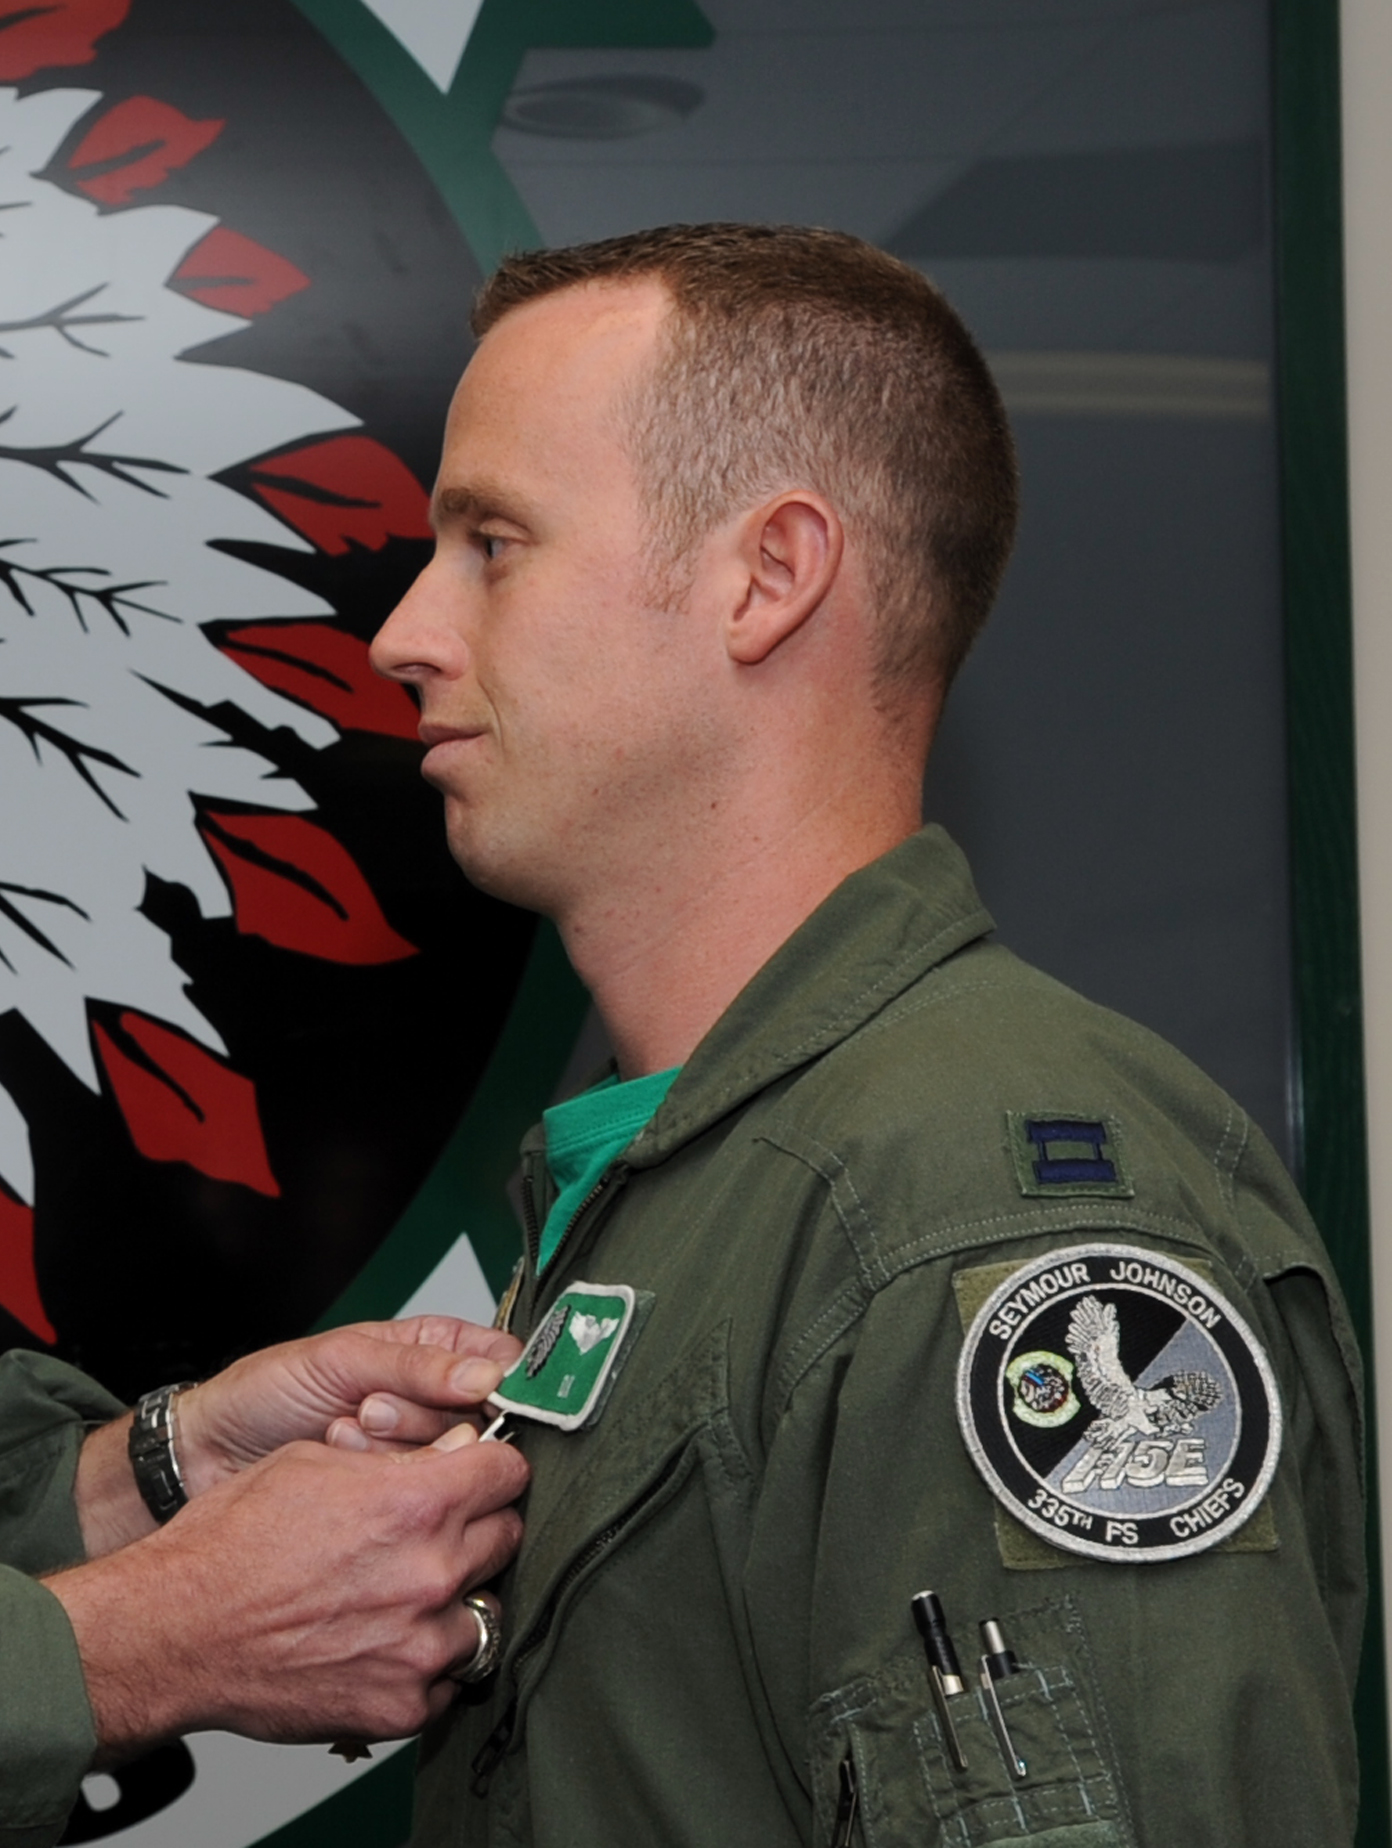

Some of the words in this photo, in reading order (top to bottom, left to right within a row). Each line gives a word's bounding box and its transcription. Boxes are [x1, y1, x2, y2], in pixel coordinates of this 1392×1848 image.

[989, 1262, 1091, 1340] SEYMOUR
[1110, 1261, 1222, 1329] JOHNSON
[1028, 1489, 1094, 1530] 335TH
[1105, 1521, 1139, 1545] FS
[1170, 1477, 1245, 1538] CHIEFS
